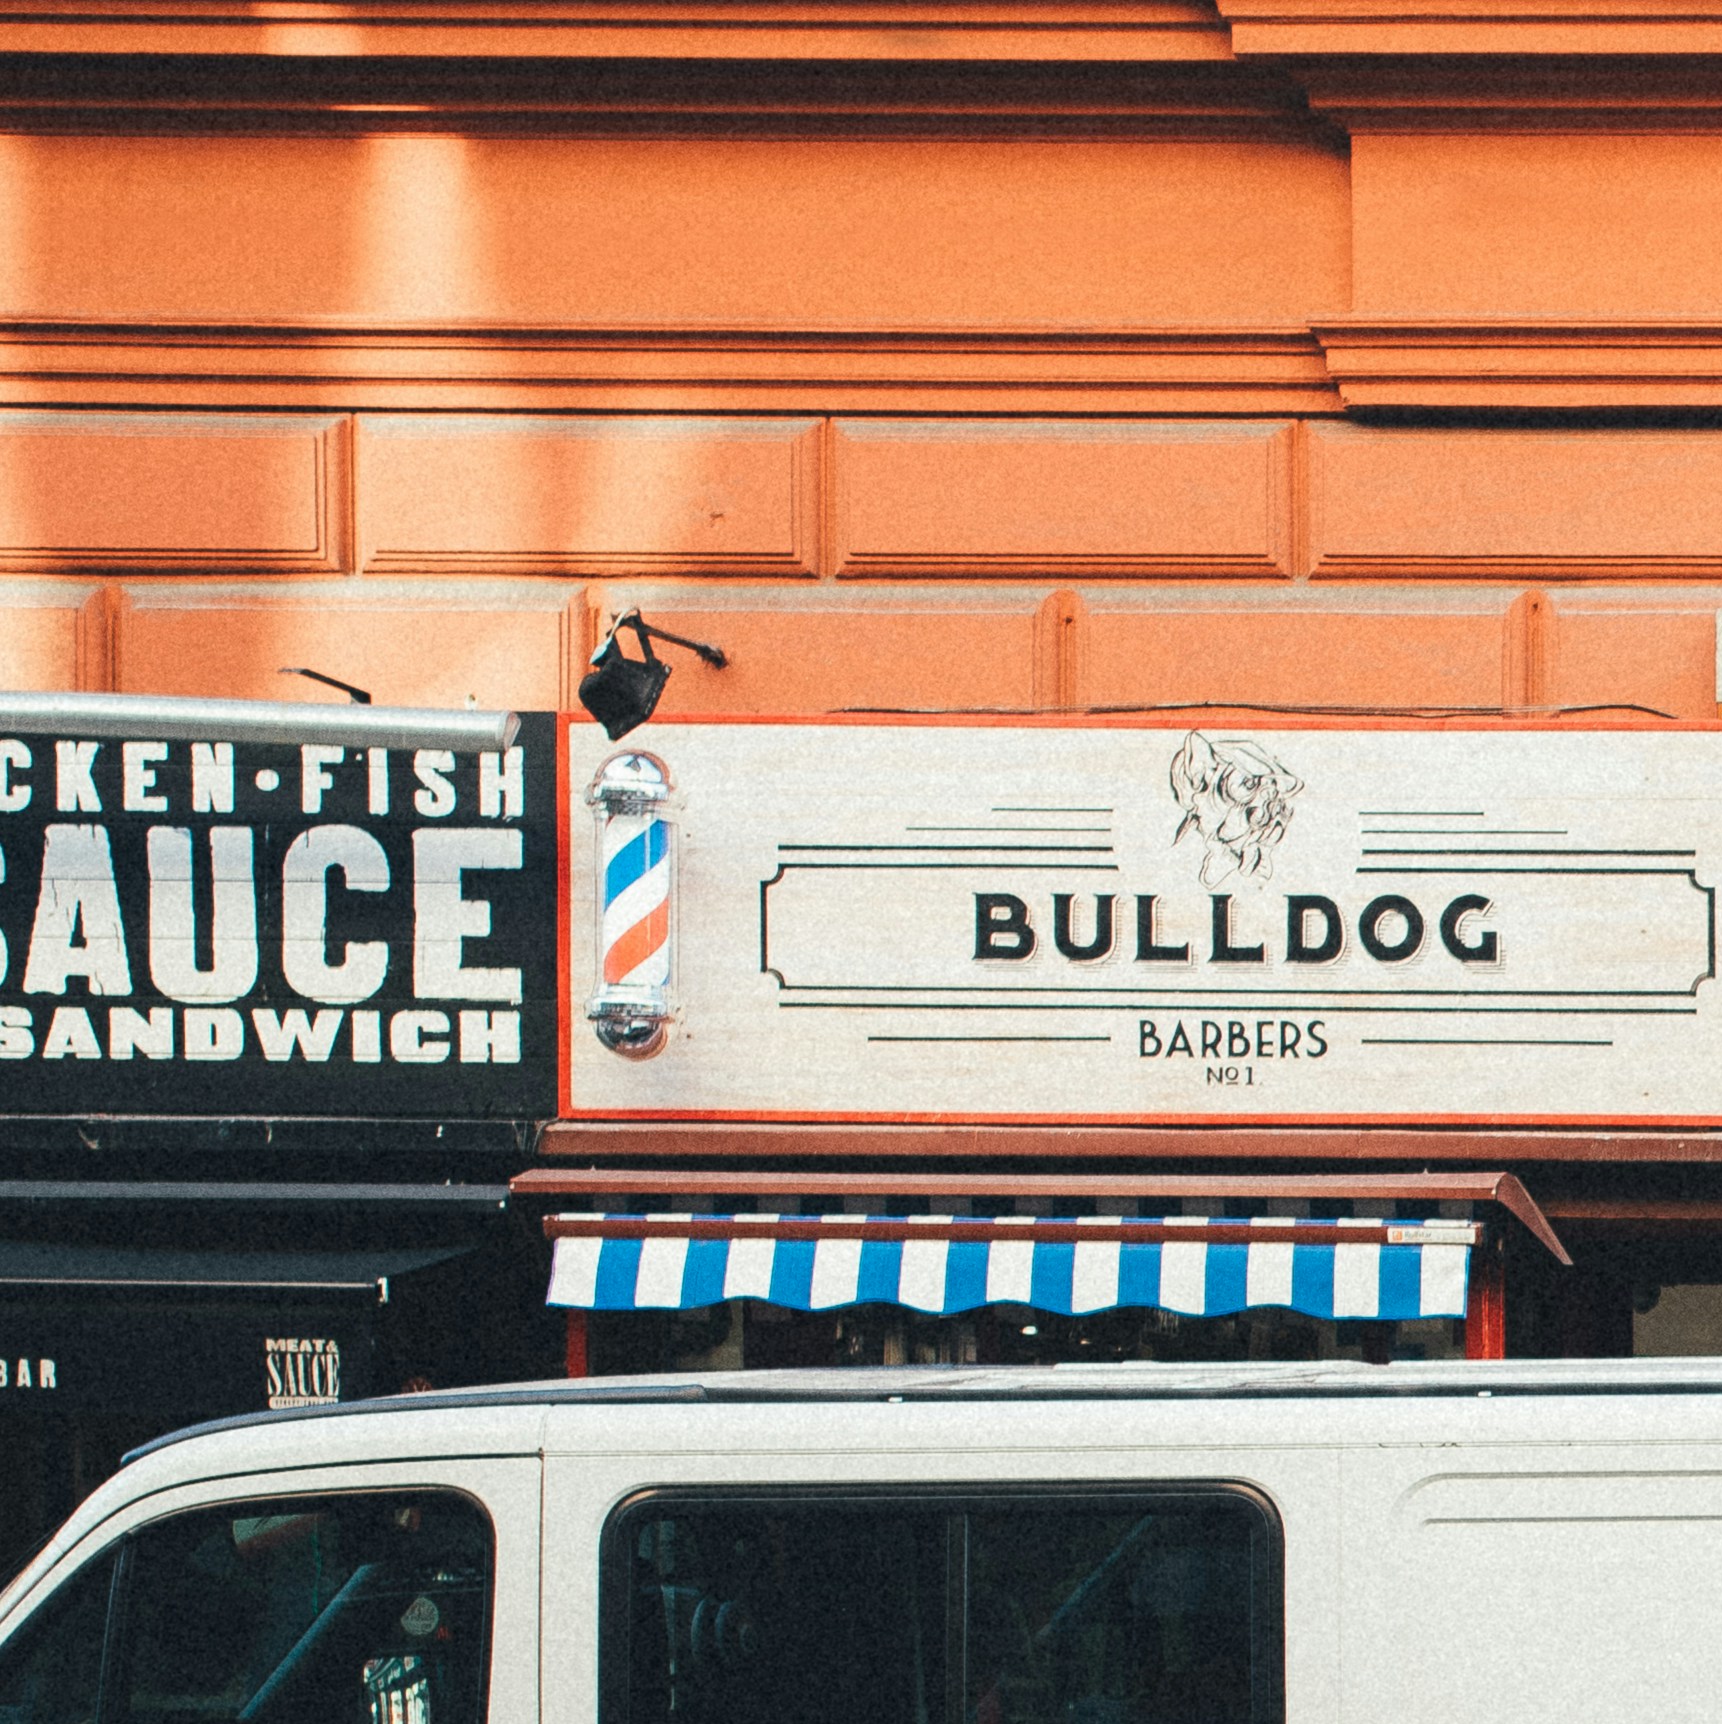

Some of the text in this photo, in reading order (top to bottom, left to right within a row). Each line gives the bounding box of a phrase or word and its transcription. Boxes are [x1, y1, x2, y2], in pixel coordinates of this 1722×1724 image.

[301, 744, 523, 818] FISH
[0, 824, 523, 1005] AUCE
[972, 893, 1502, 964] BULLDOG
[0, 1006, 521, 1063] SANDWICH
[1140, 1020, 1327, 1058] BARBERS
[266, 1353, 340, 1396] SAUCE
